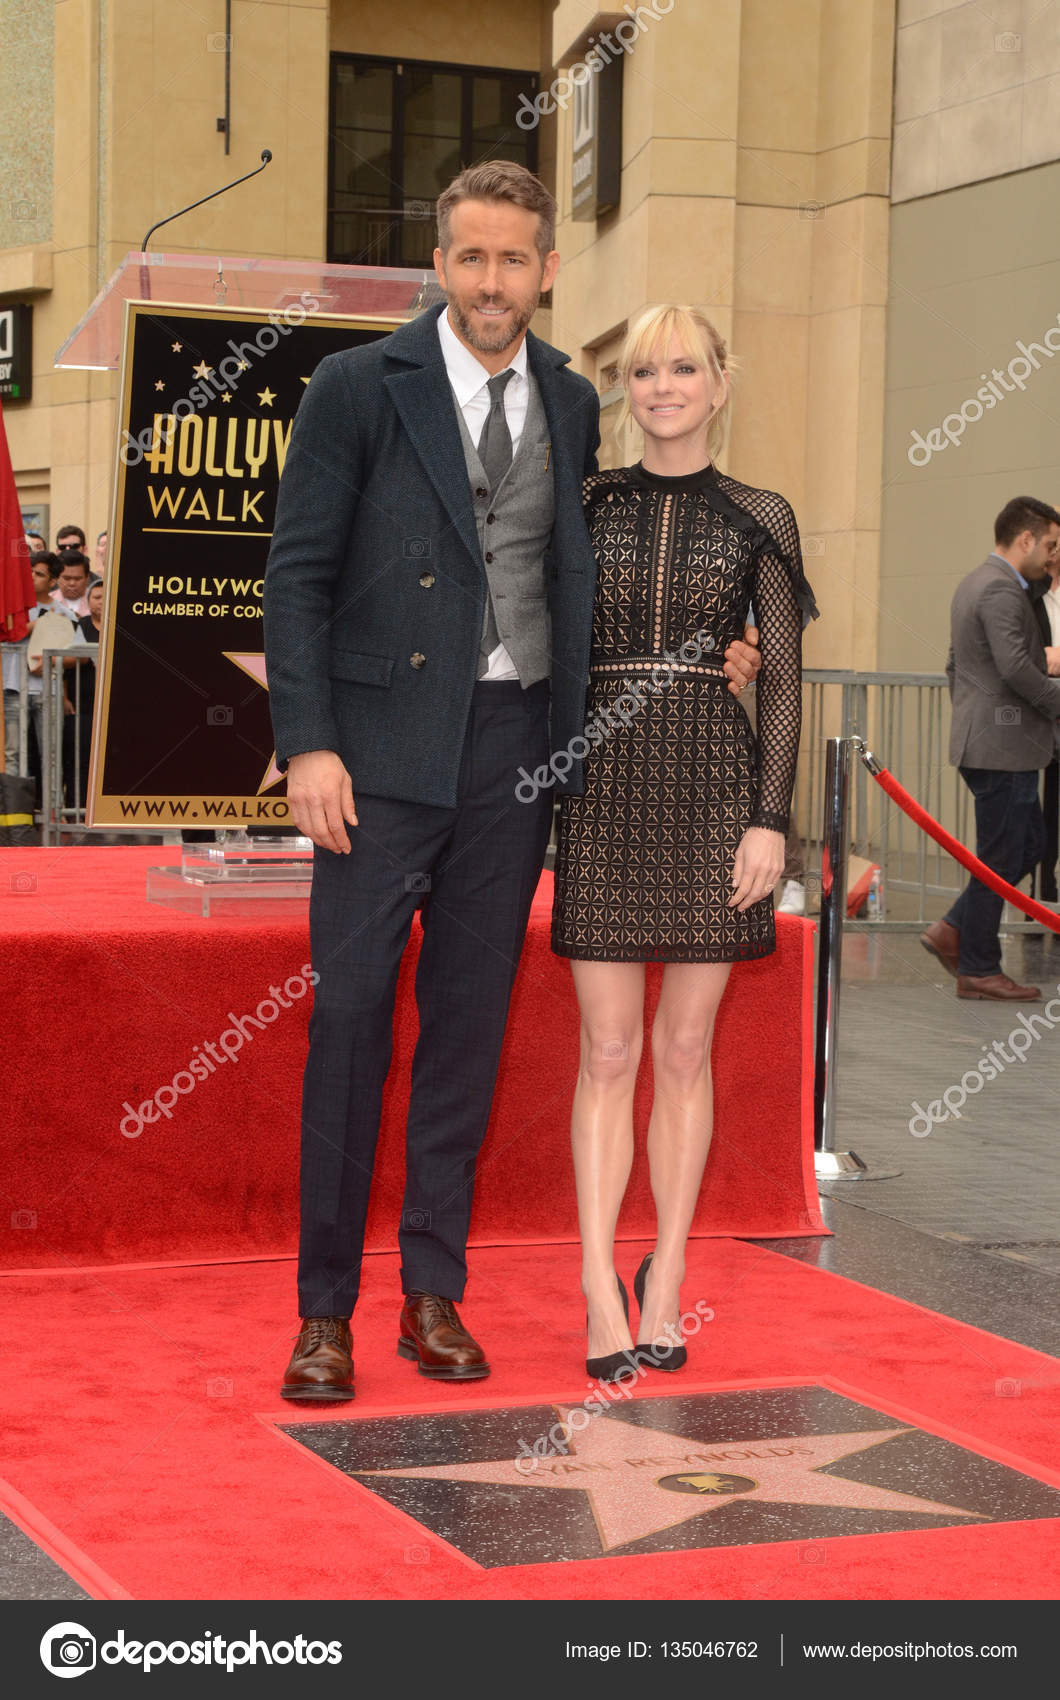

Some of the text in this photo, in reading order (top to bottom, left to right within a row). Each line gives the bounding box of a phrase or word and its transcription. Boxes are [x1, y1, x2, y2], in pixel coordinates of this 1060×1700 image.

[147, 485, 265, 523] WALK
[132, 602, 204, 617] CHAMBER
[208, 604, 229, 617] OF
[622, 1445, 816, 1469] REYNOLDS
